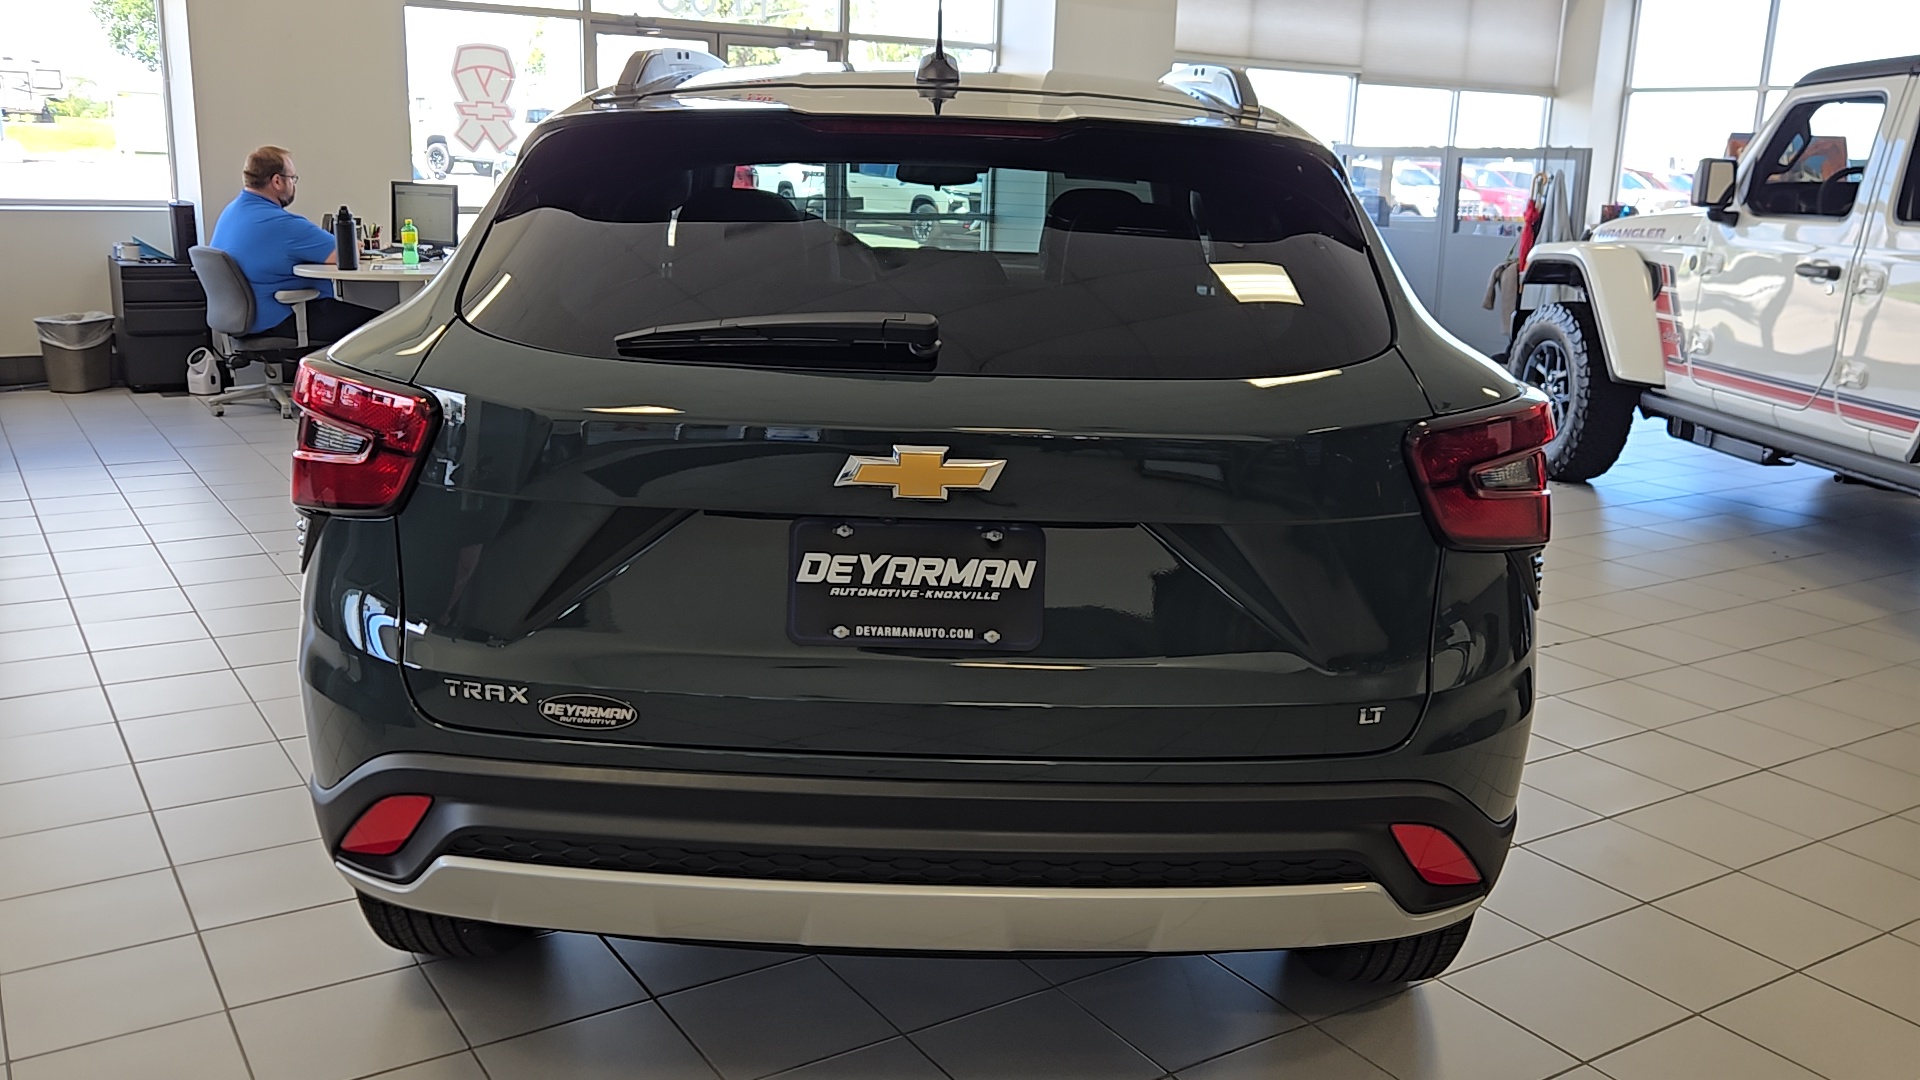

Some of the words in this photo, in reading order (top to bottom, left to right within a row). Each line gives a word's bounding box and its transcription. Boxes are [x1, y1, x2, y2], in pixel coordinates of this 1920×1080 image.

[1598, 227, 1666, 239] WRANGLER
[796, 552, 1037, 589] DEYARMAN
[829, 586, 1000, 601] AUTOMOTIVE-KNOXVILLE
[855, 625, 974, 640] DEYARMANAUTO.COM
[443, 678, 528, 704] TRAX
[543, 702, 633, 721] DEYARMAN
[1359, 706, 1386, 724] LT
[559, 715, 616, 726] AUTOMOTIVE
